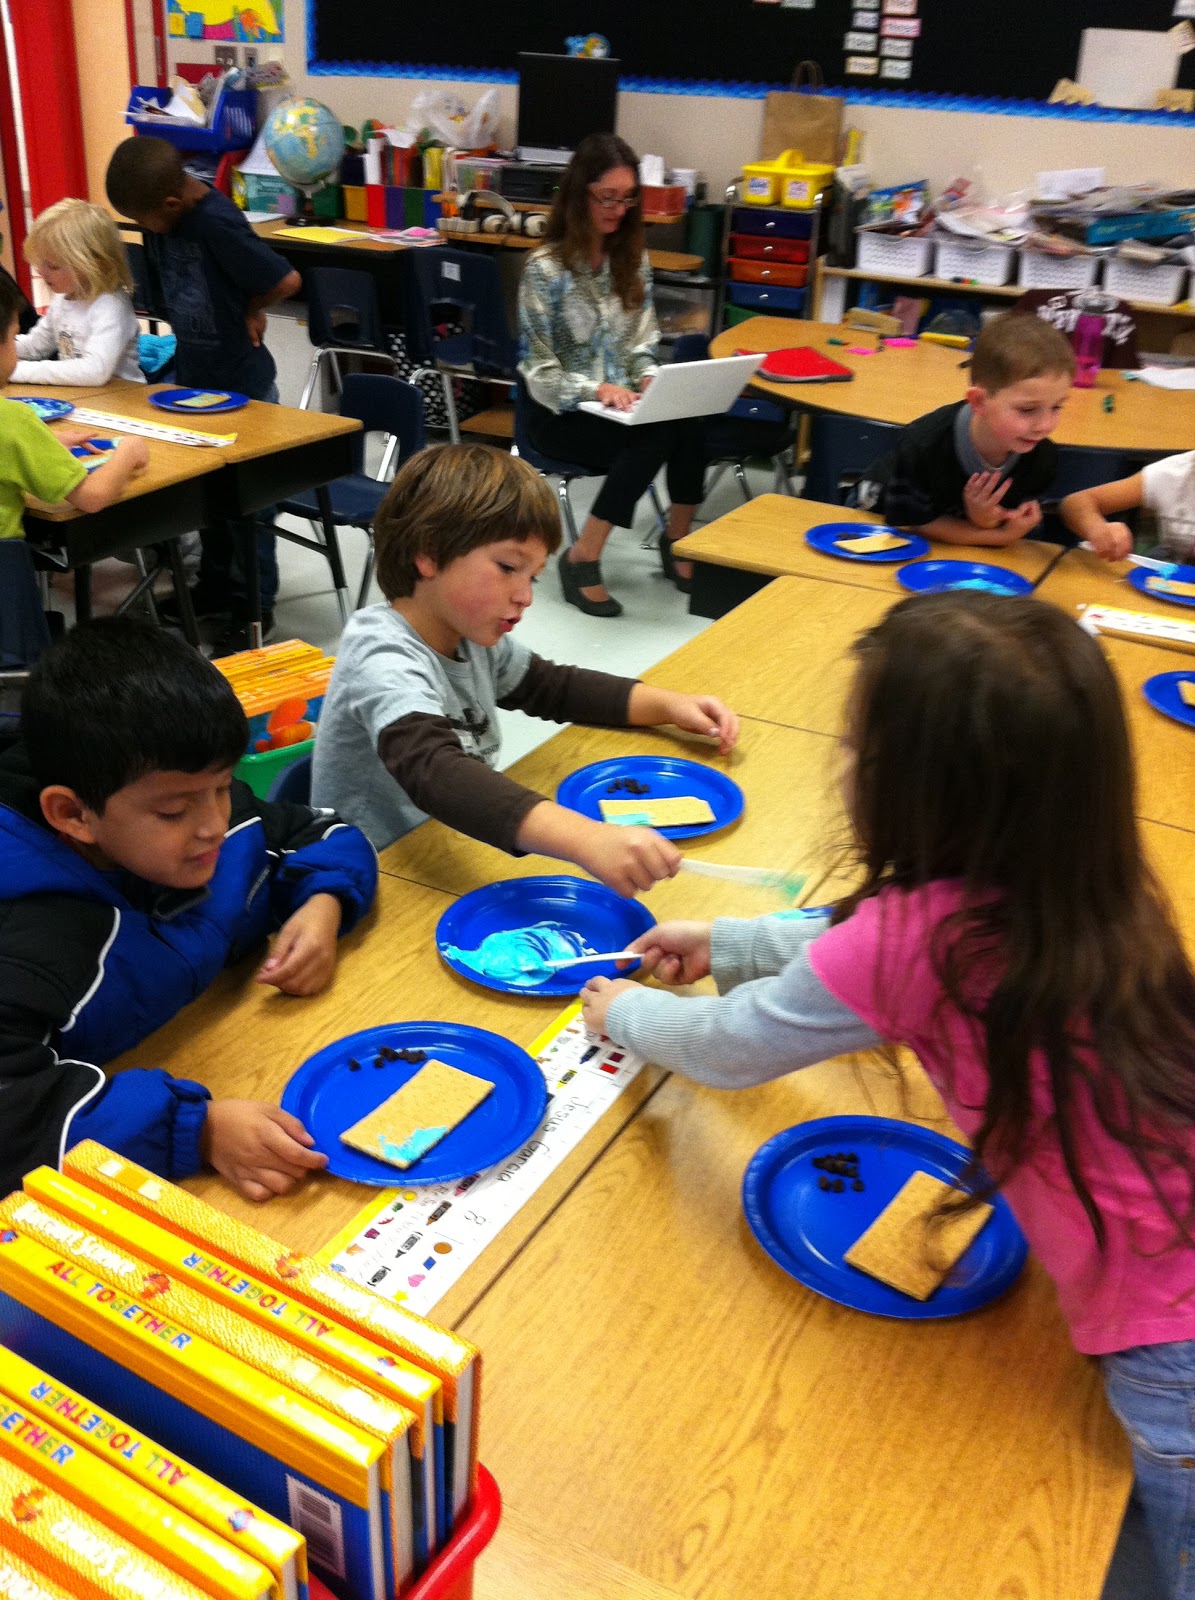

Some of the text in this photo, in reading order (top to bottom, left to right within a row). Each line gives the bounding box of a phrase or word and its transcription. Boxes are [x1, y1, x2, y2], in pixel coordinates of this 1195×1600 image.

[496, 1096, 590, 1182] Jesus Garcia
[47, 1260, 193, 1351] ALL TOGETHER
[182, 1251, 289, 1317] TOGETHER
[293, 1310, 335, 1342] ALL
[29, 1381, 191, 1486] ALL TOGETHER
